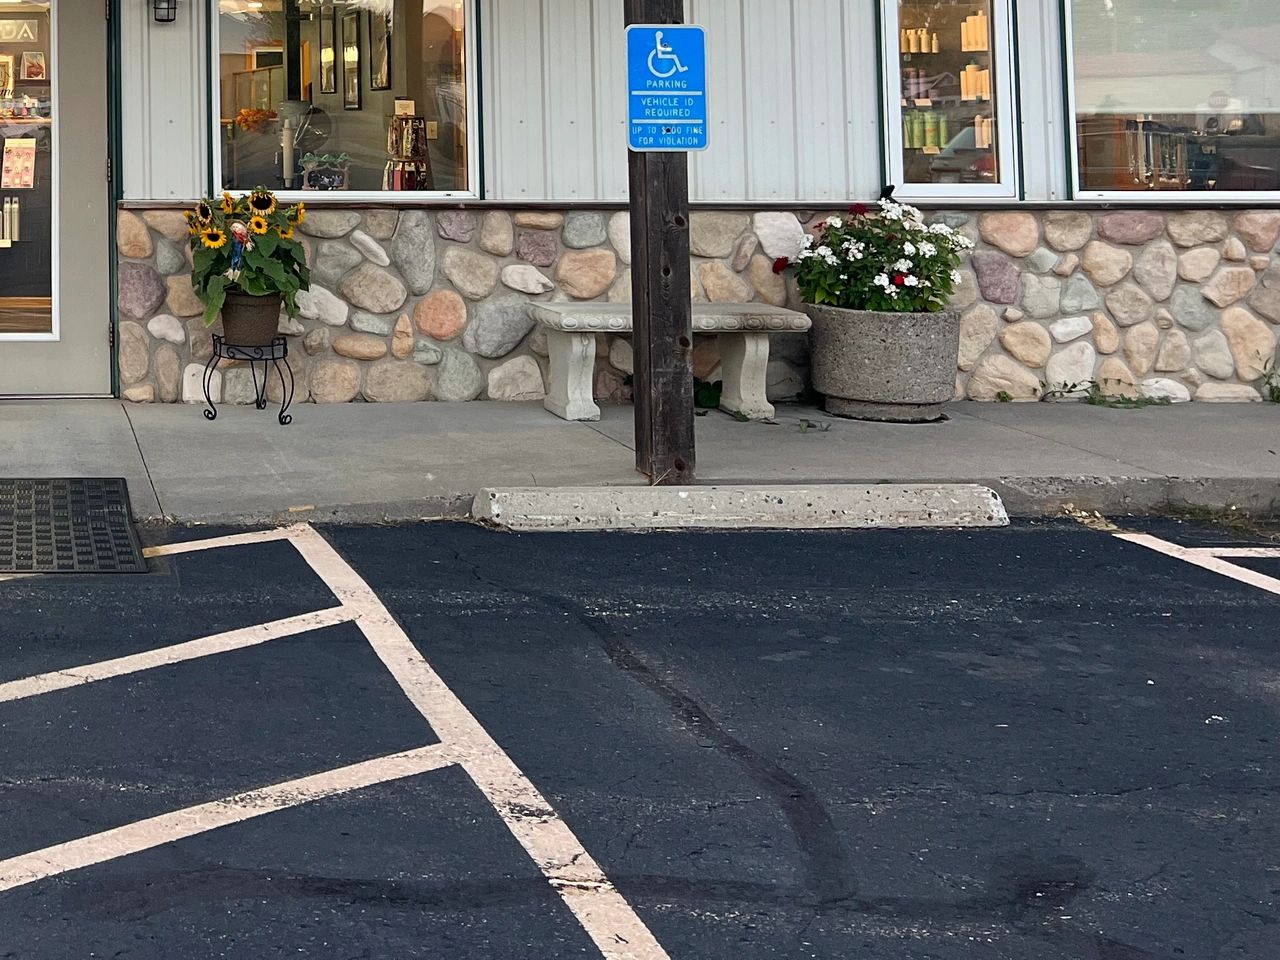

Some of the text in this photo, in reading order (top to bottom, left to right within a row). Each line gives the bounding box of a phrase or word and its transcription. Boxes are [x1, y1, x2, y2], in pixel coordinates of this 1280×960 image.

[646, 79, 688, 89] PARKING
[640, 97, 694, 106] VEHICLE ID
[644, 108, 691, 117] REQUIRED
[632, 126, 704, 135] UP TO $00 FINE
[638, 136, 698, 145] FOR VIOLATION
